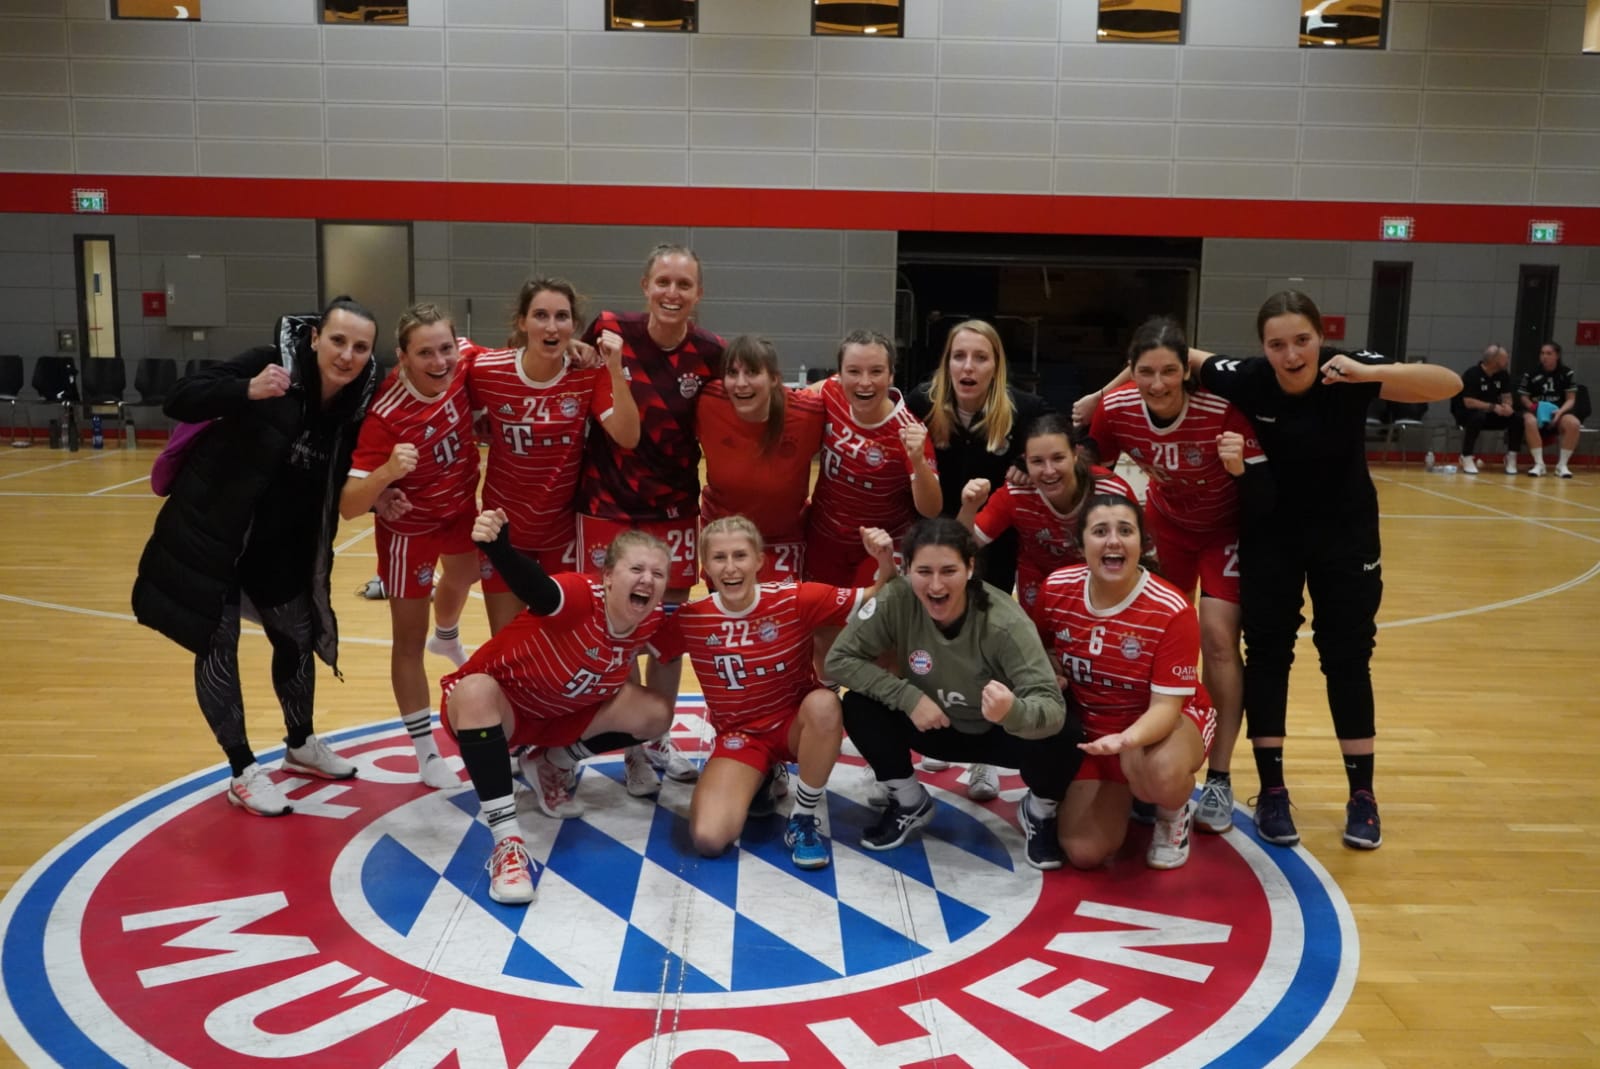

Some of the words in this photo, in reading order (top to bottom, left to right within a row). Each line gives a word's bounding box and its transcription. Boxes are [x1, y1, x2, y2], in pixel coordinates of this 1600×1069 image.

[444, 398, 460, 424] 9
[522, 397, 550, 422] 24
[1151, 442, 1179, 470] 20
[667, 528, 695, 562] 29
[721, 621, 755, 648] 22
[1089, 625, 1106, 656] 6
[1171, 665, 1198, 678] QATA
